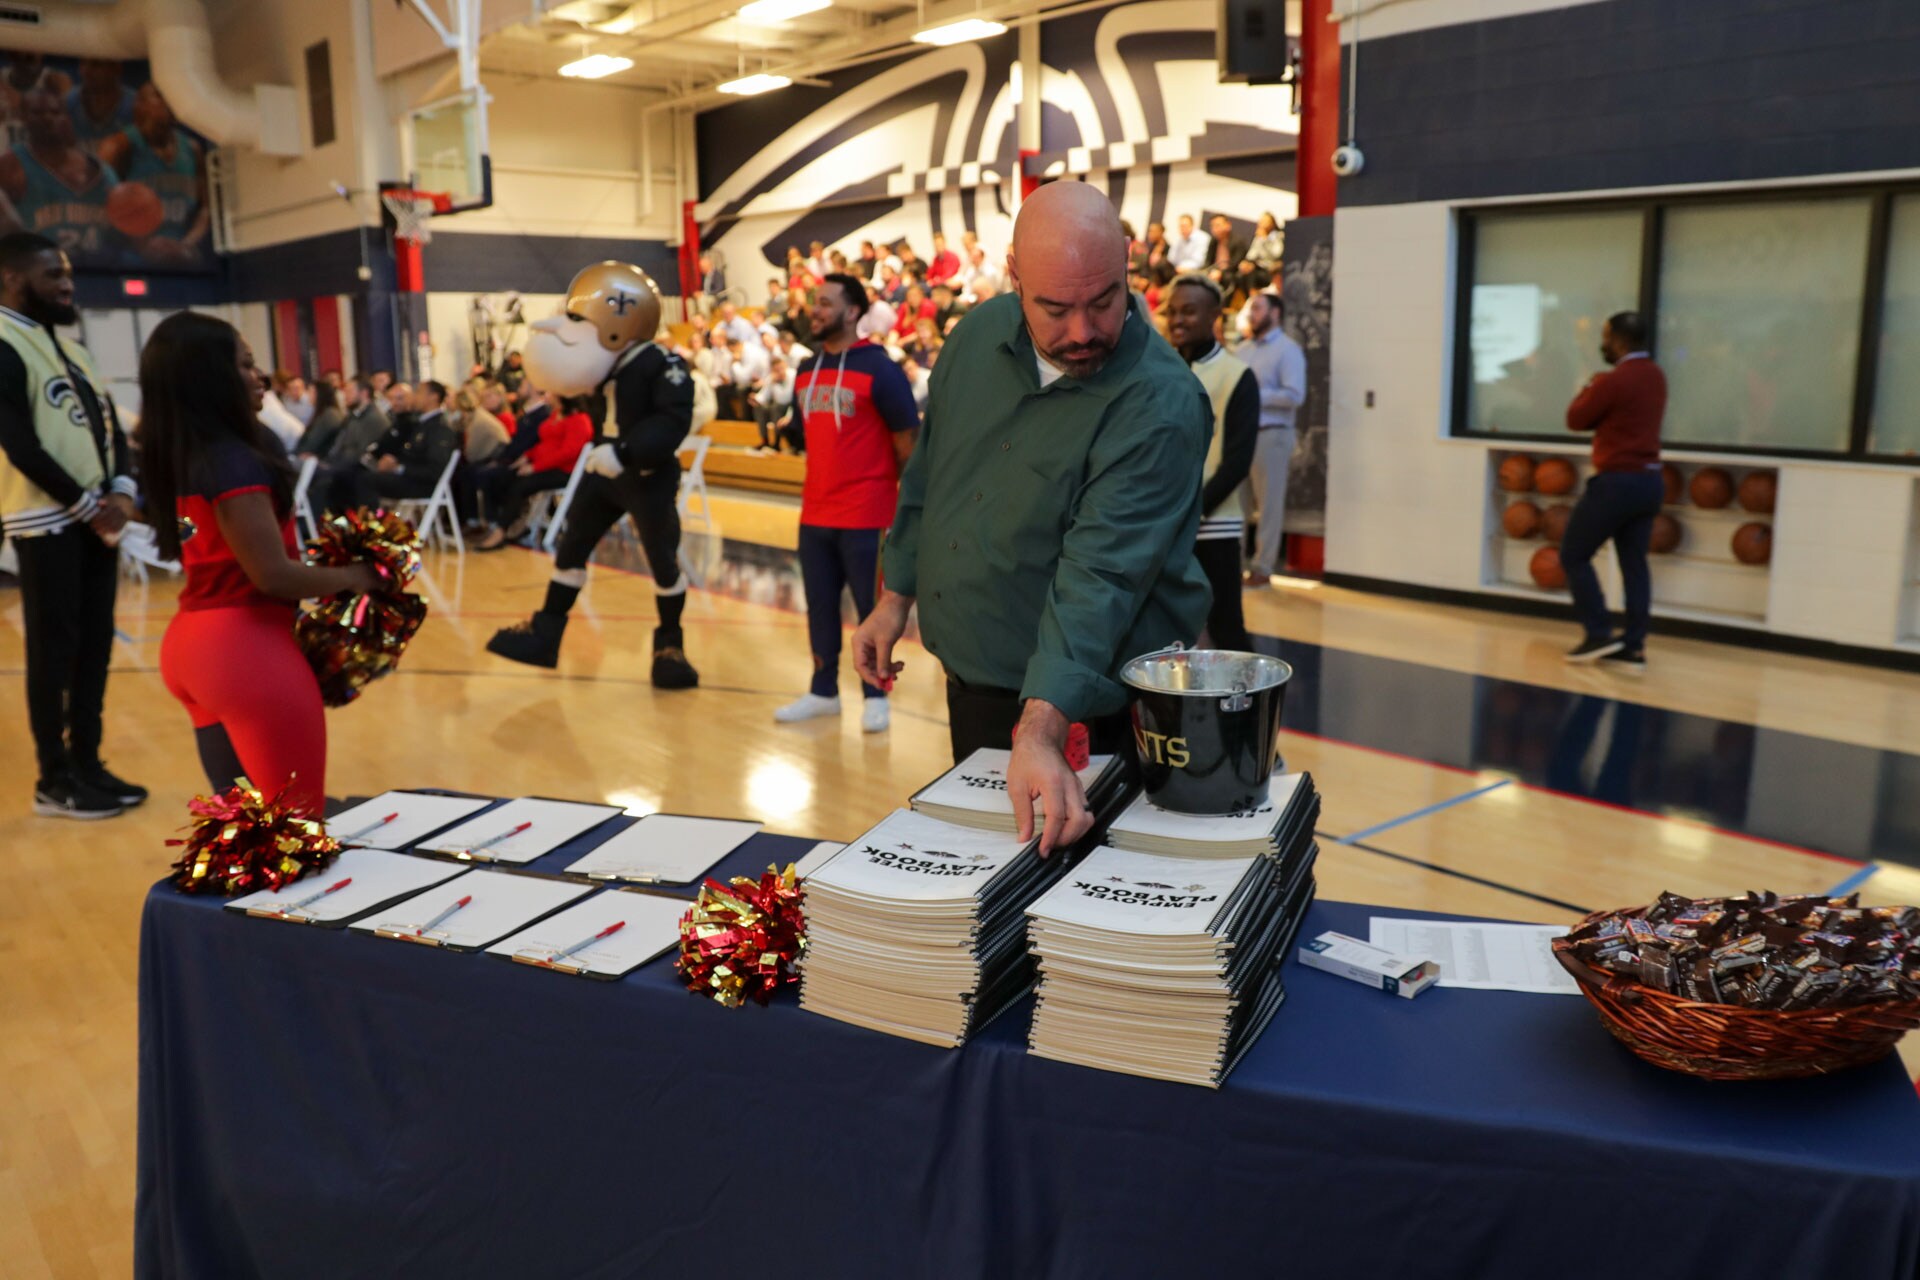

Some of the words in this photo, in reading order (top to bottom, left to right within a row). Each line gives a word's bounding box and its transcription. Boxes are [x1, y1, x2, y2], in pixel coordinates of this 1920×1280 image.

[861, 846, 996, 871] PLAYBOOK
[868, 857, 974, 876] EMPLOYEE
[1072, 881, 1217, 902] PLAYBOOK
[1082, 890, 1196, 908] EMPLOYEE
